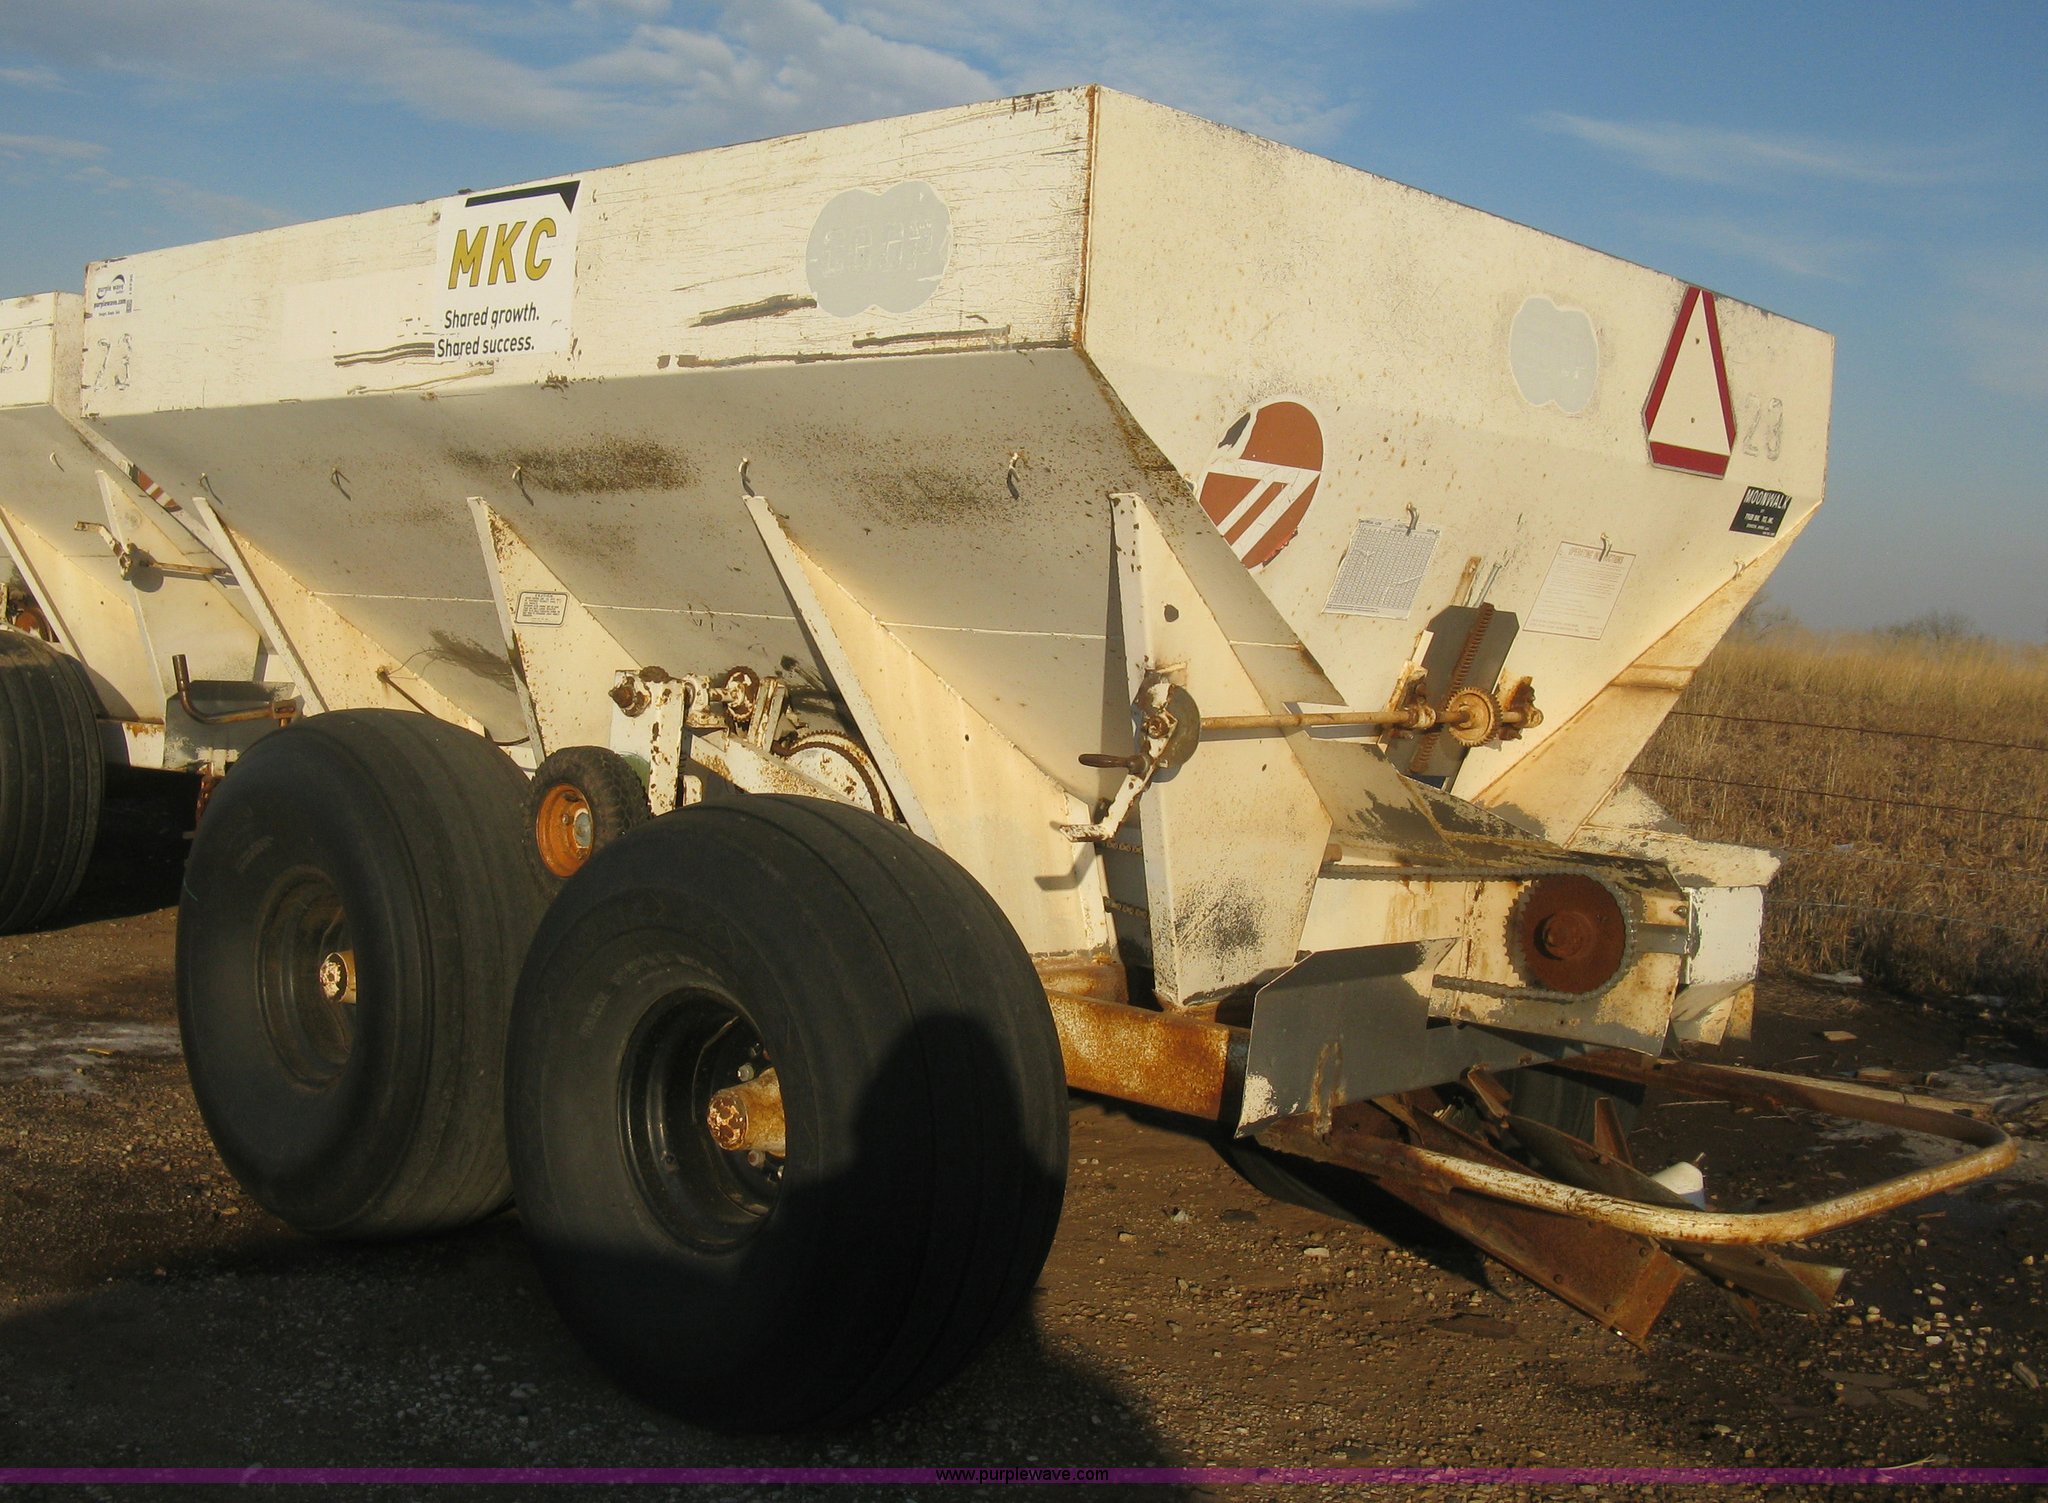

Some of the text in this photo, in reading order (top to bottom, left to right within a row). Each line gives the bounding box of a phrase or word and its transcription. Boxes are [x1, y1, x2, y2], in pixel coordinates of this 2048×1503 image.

[448, 217, 557, 290] MKC
[444, 302, 540, 329] Shared growth.
[437, 335, 535, 358] Shared success.
[1743, 489, 1791, 510] MOONWALK
